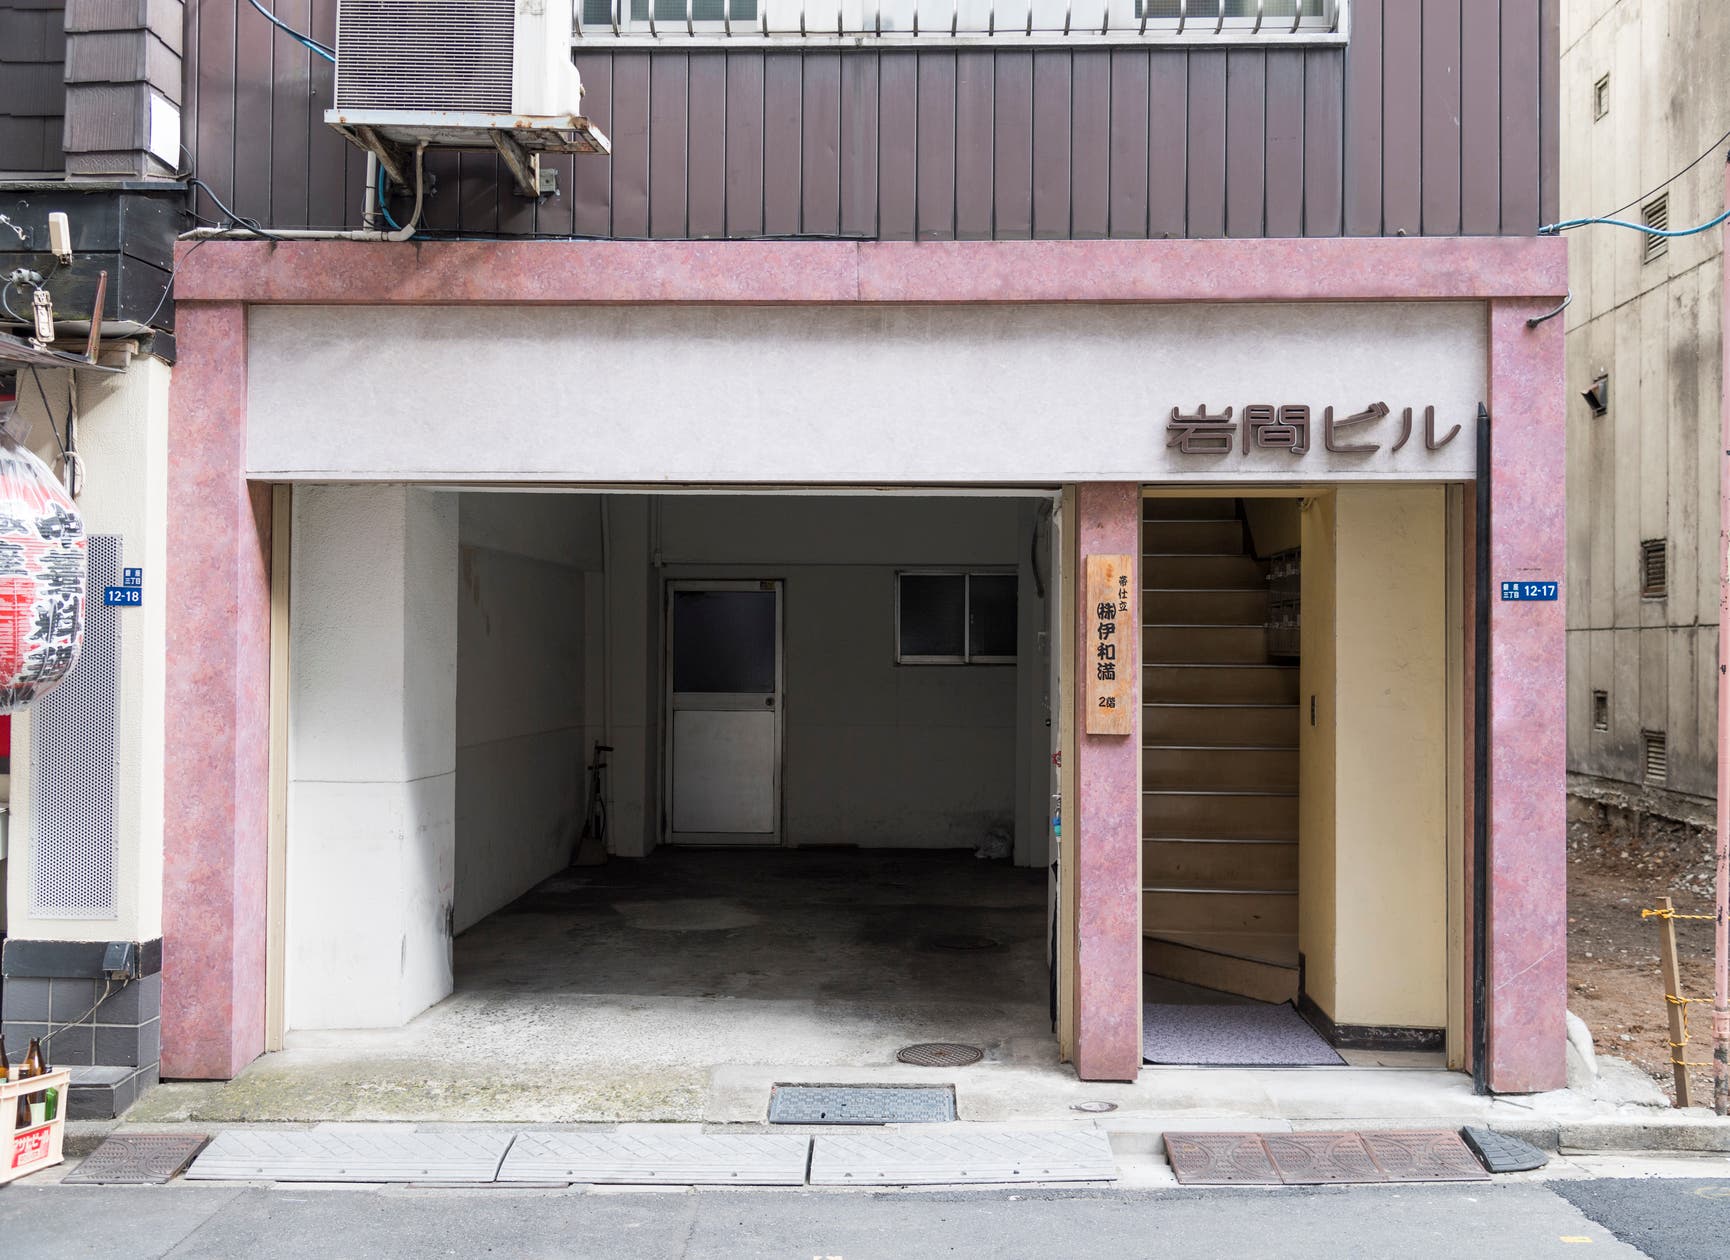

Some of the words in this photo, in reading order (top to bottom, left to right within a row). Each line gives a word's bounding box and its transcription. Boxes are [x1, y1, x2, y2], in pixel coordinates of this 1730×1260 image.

[1166, 401, 1462, 455] 岩間ビル
[108, 590, 139, 602] 12-18
[1118, 575, 1128, 612] 帯仕立
[1524, 585, 1555, 597] 12-17
[1098, 696, 1116, 709] 2階
